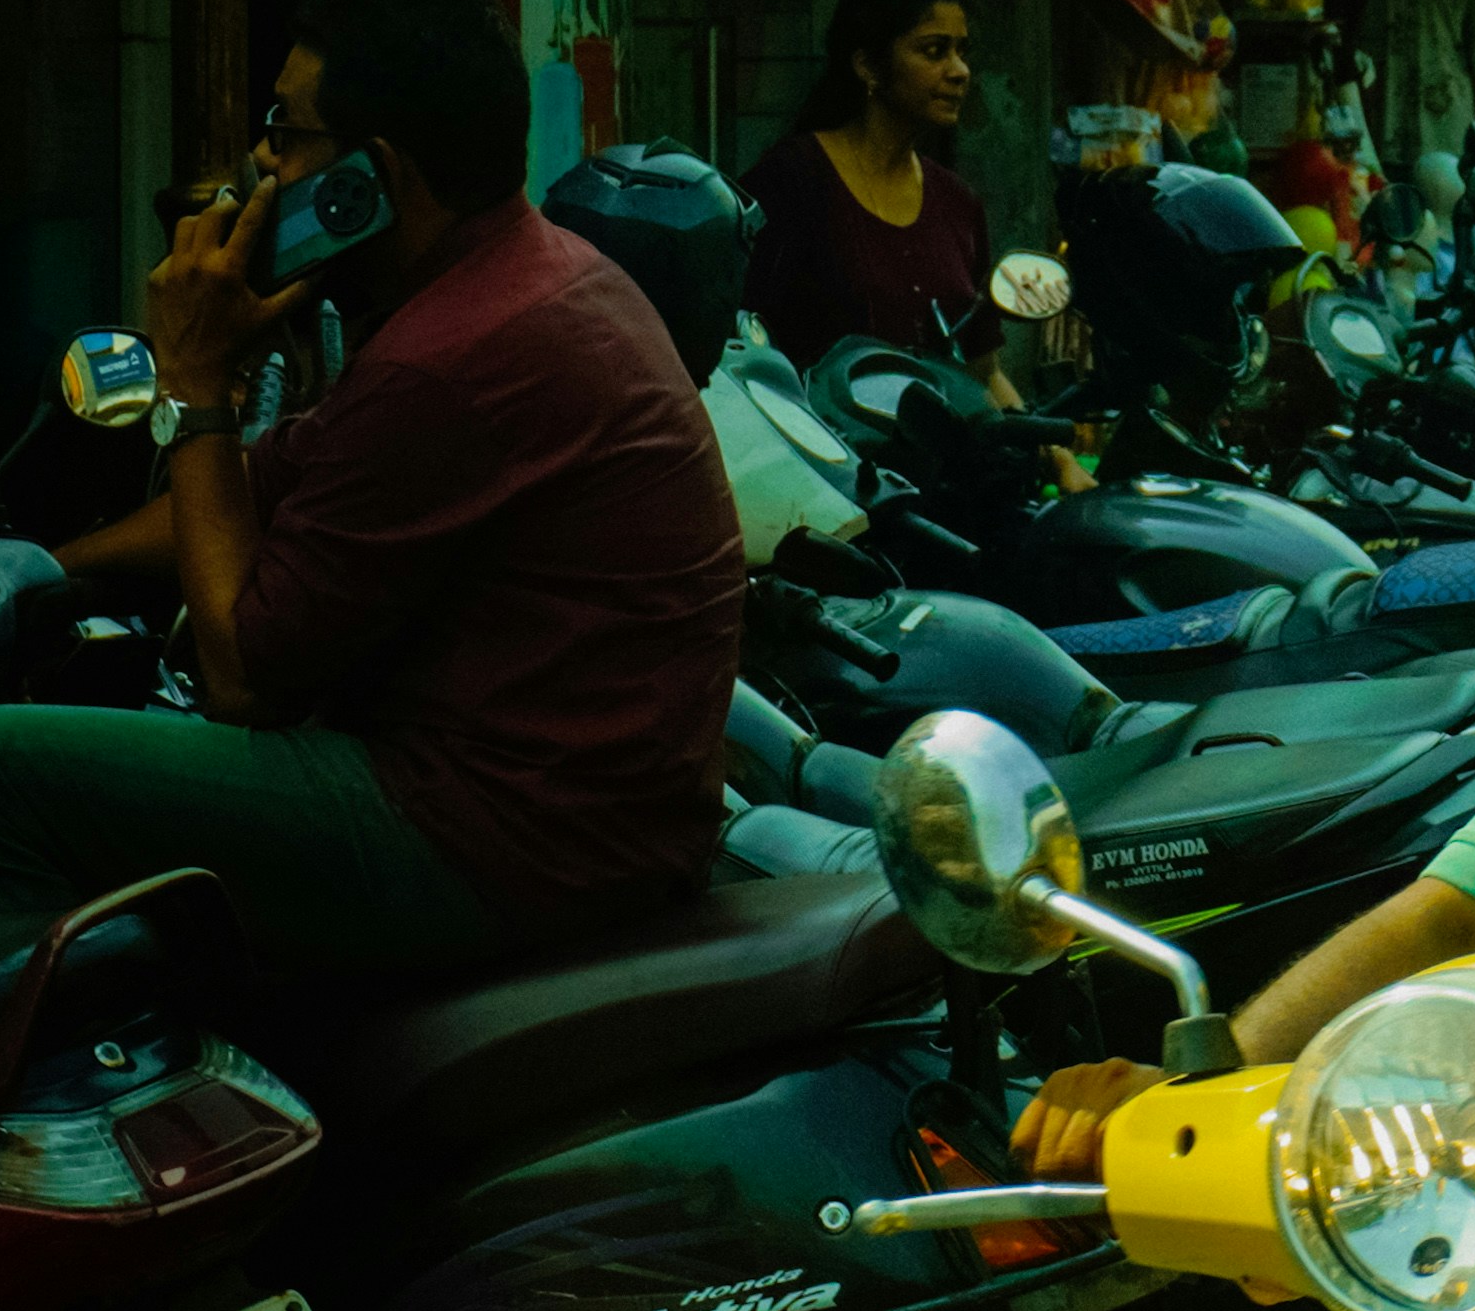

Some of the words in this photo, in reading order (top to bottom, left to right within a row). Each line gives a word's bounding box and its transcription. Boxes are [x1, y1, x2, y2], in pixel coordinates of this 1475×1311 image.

[1092, 847, 1136, 871] EVM
[1140, 836, 1210, 863] HONDA
[680, 1267, 804, 1308] Honda
